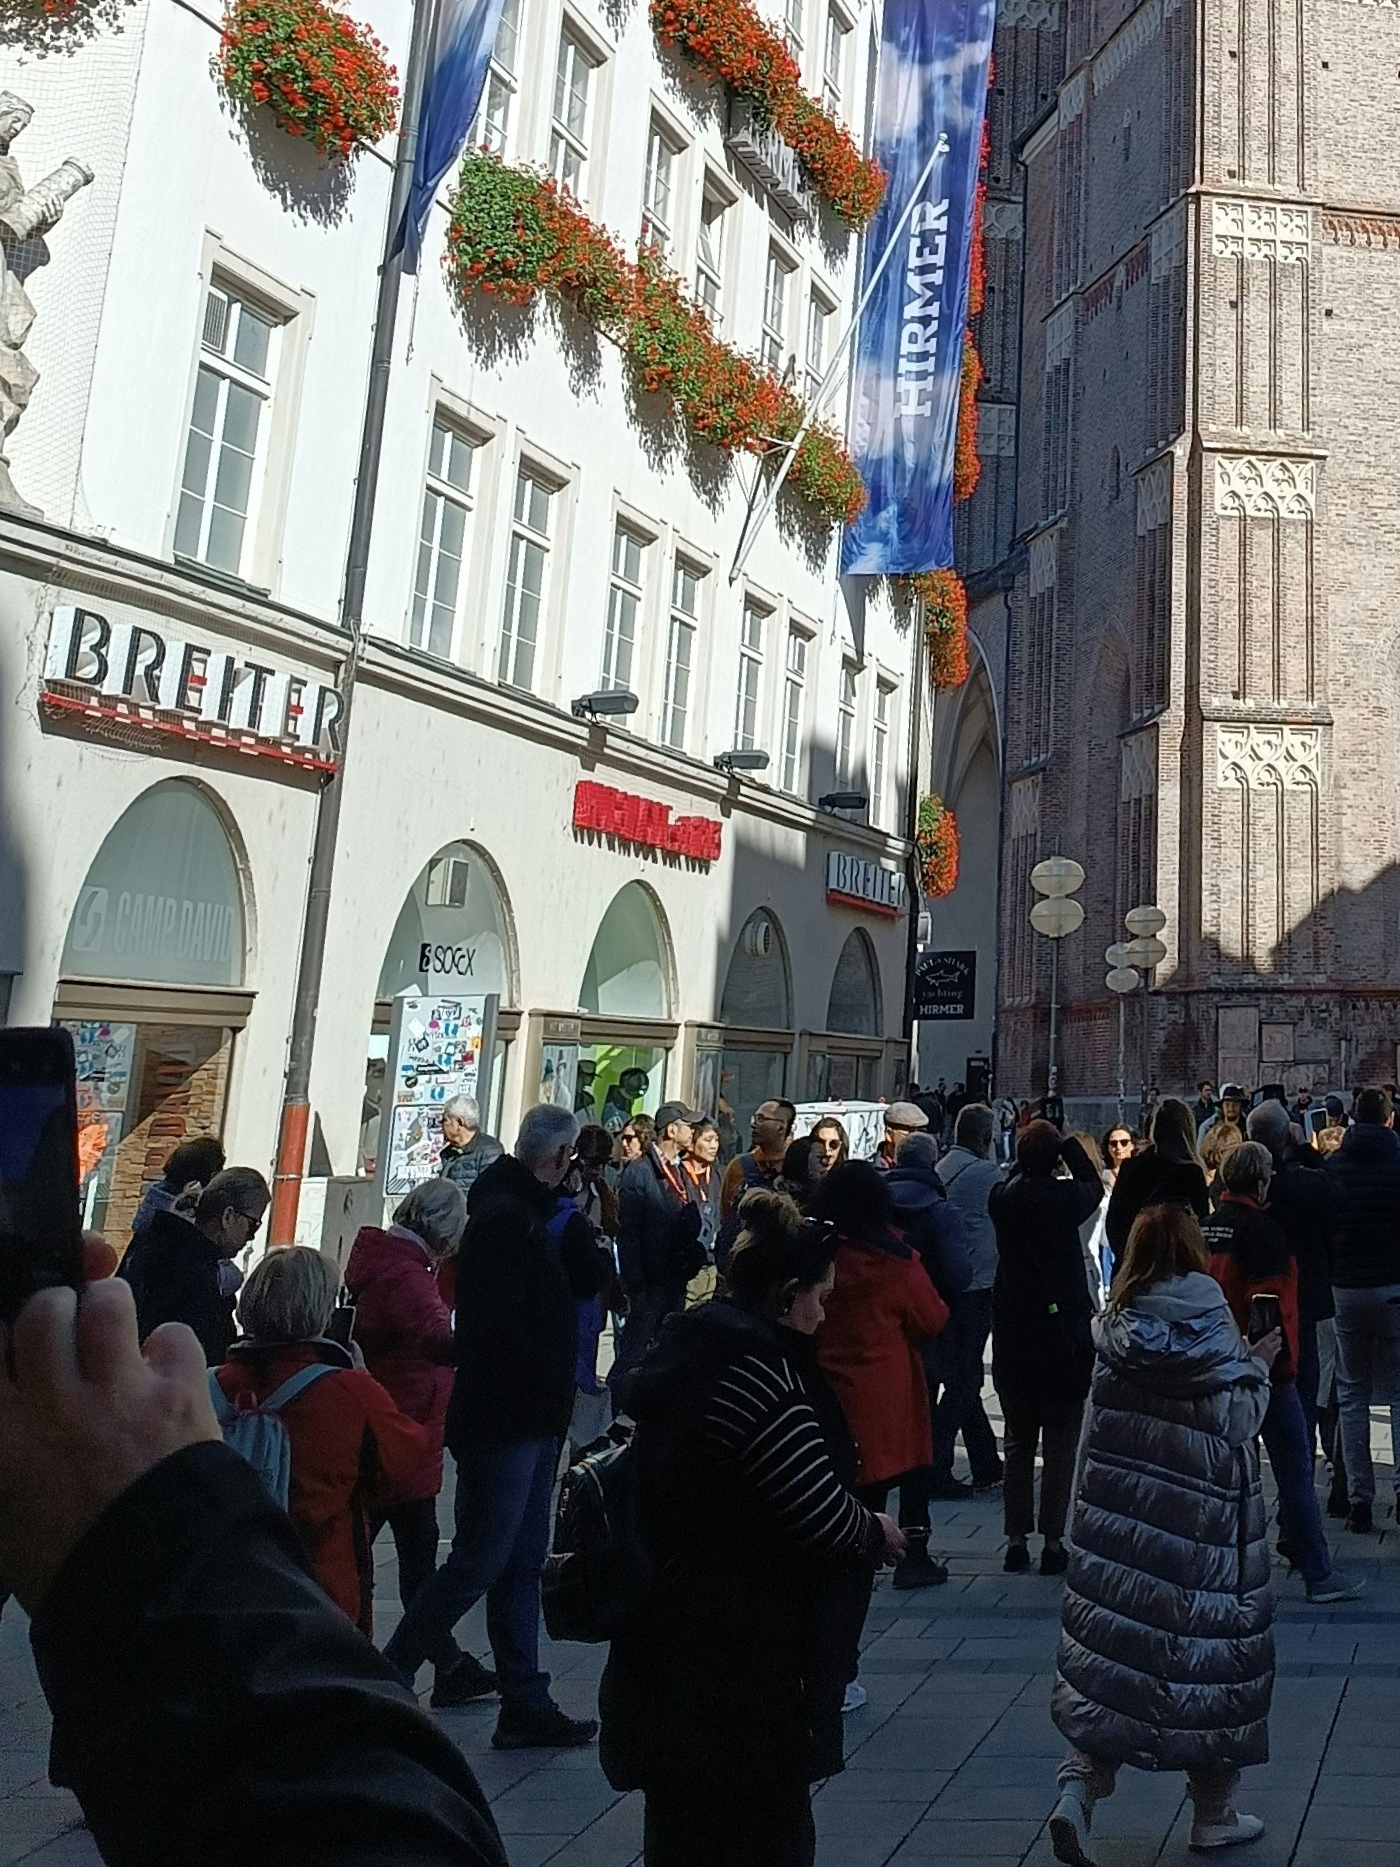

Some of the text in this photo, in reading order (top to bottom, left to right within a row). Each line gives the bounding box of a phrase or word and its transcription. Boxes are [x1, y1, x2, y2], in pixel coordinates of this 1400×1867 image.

[893, 198, 951, 423] HIRMER
[58, 606, 346, 754] BREITER
[836, 852, 907, 908] BREITER
[113, 891, 236, 963] CAMP DAVID
[920, 1004, 964, 1015] HIRMER
